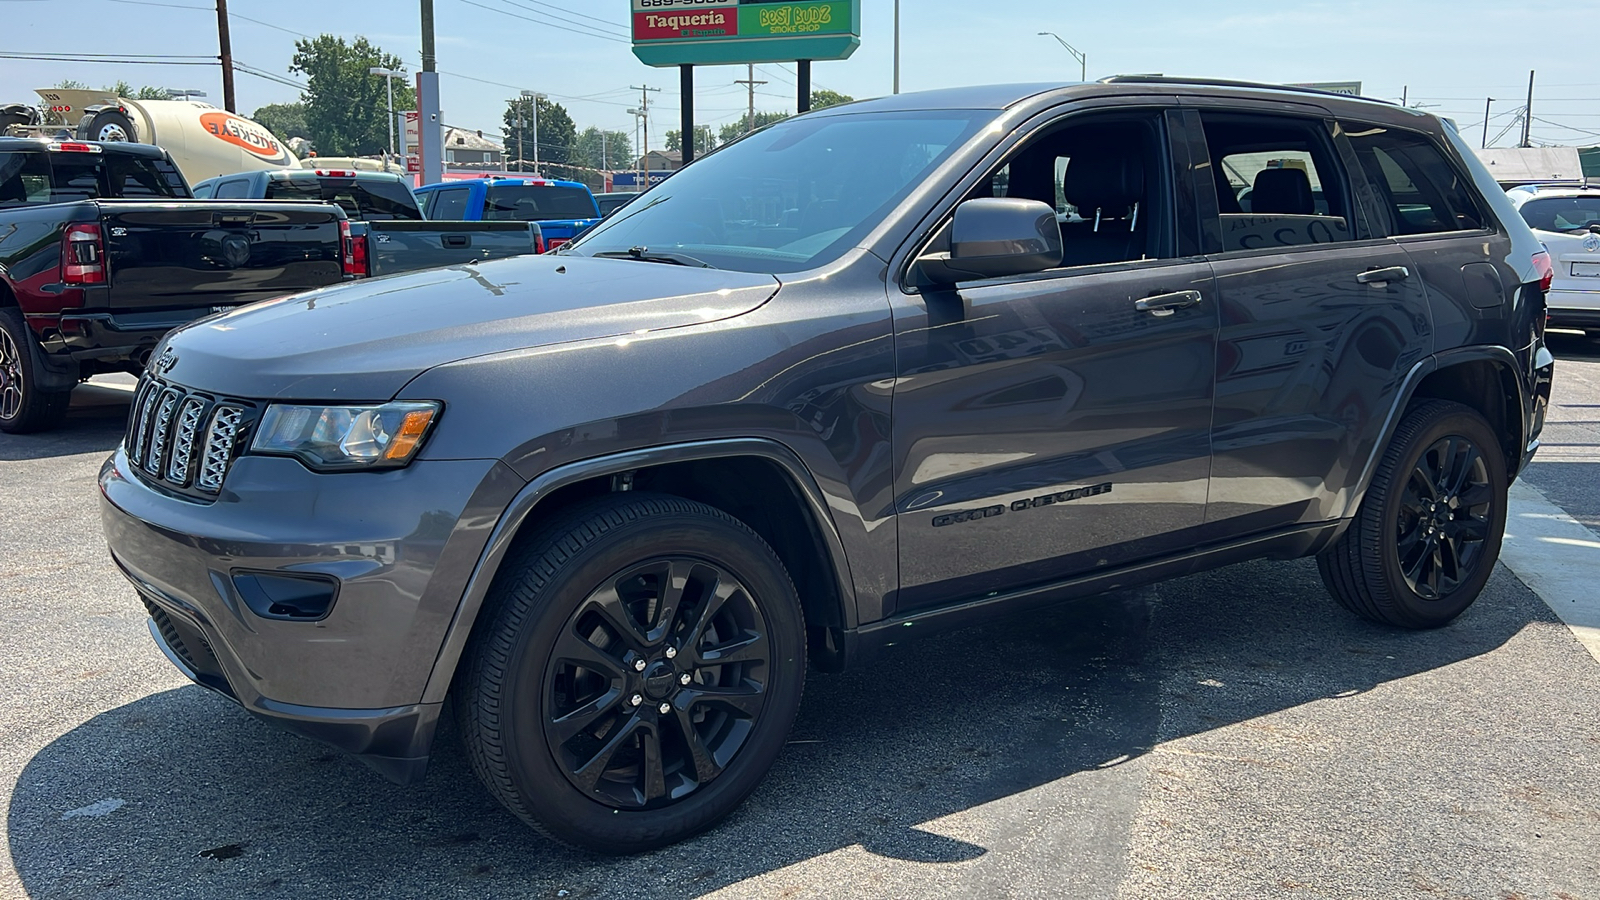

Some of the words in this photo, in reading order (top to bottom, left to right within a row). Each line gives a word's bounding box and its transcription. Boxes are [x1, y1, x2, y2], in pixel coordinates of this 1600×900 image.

[770, 26, 797, 34] SMOKE
[798, 24, 820, 32] SHOP
[208, 122, 280, 153] BUCKEYE
[931, 504, 1005, 527] GRAND
[1011, 482, 1112, 511] CHEROKEE
